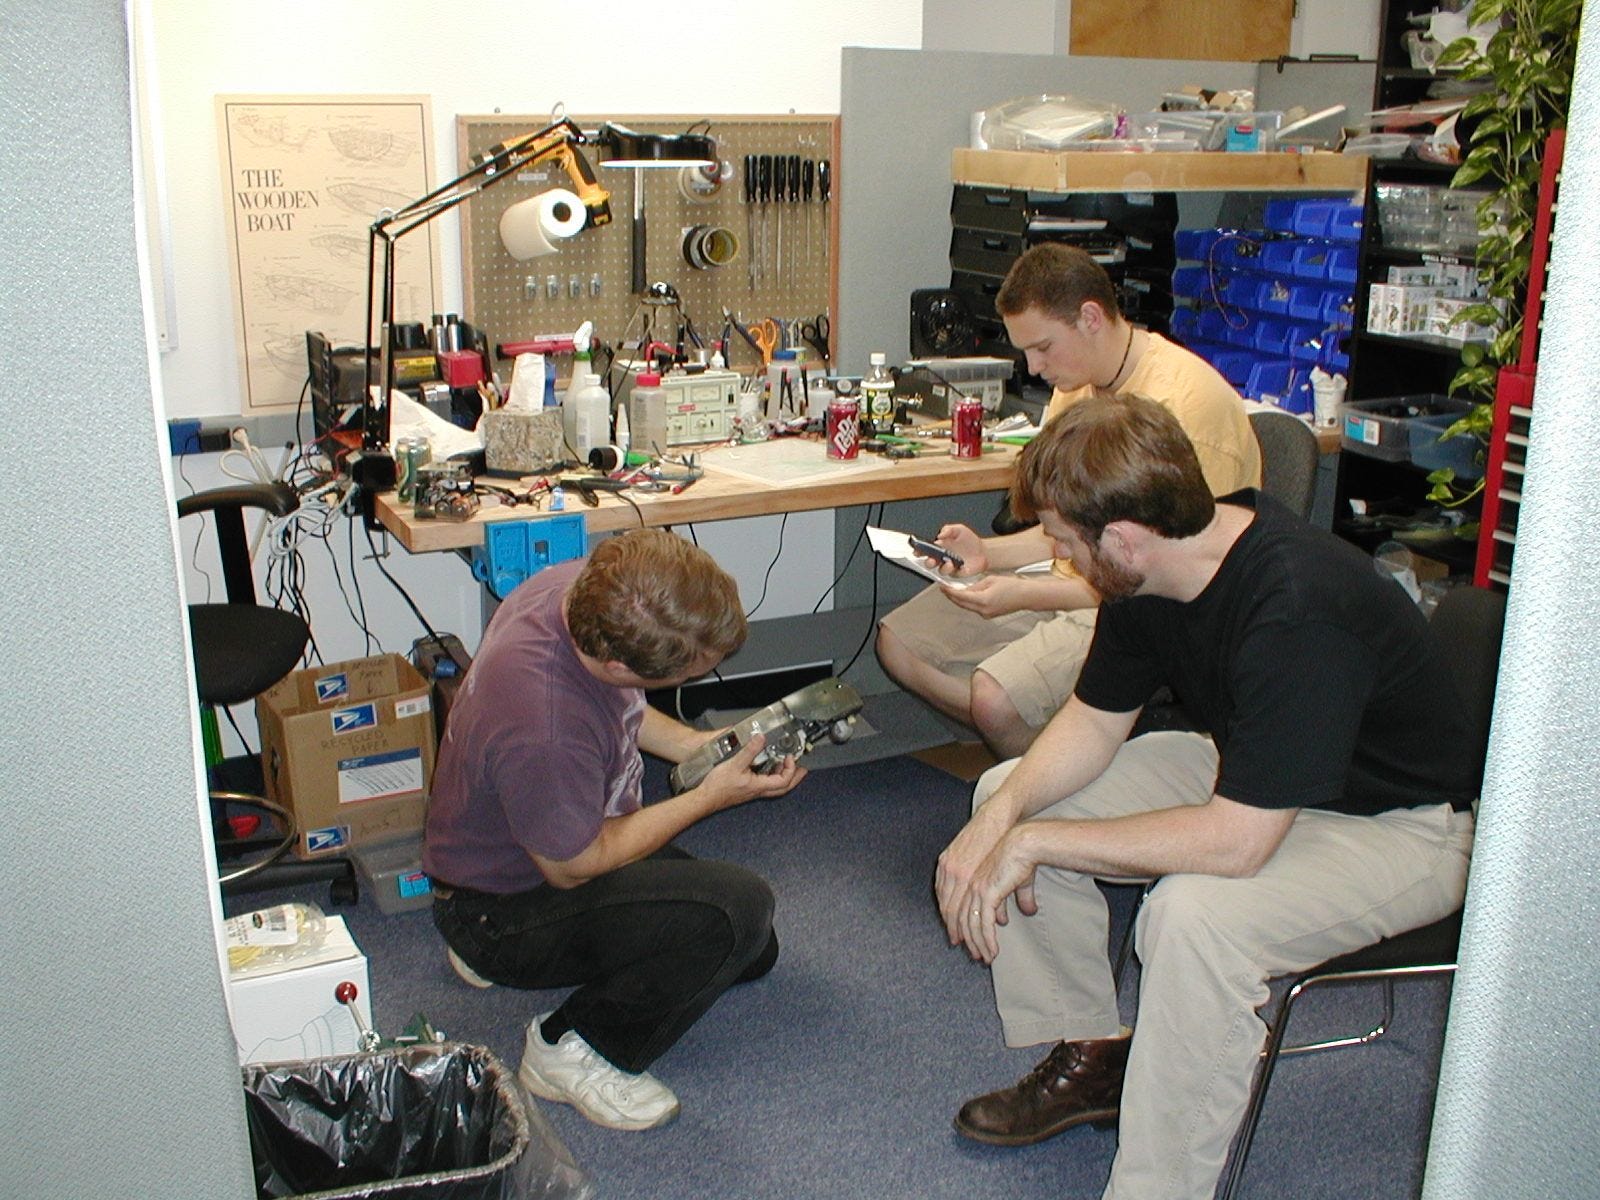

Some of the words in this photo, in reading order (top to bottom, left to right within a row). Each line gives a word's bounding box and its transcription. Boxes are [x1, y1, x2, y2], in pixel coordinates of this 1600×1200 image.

[241, 168, 284, 188] THE
[237, 190, 319, 210] WOODEN
[247, 213, 295, 232] BOAT
[837, 414, 852, 435] Dr
[320, 730, 384, 750] RECYCLED
[351, 739, 389, 755] PAPER
